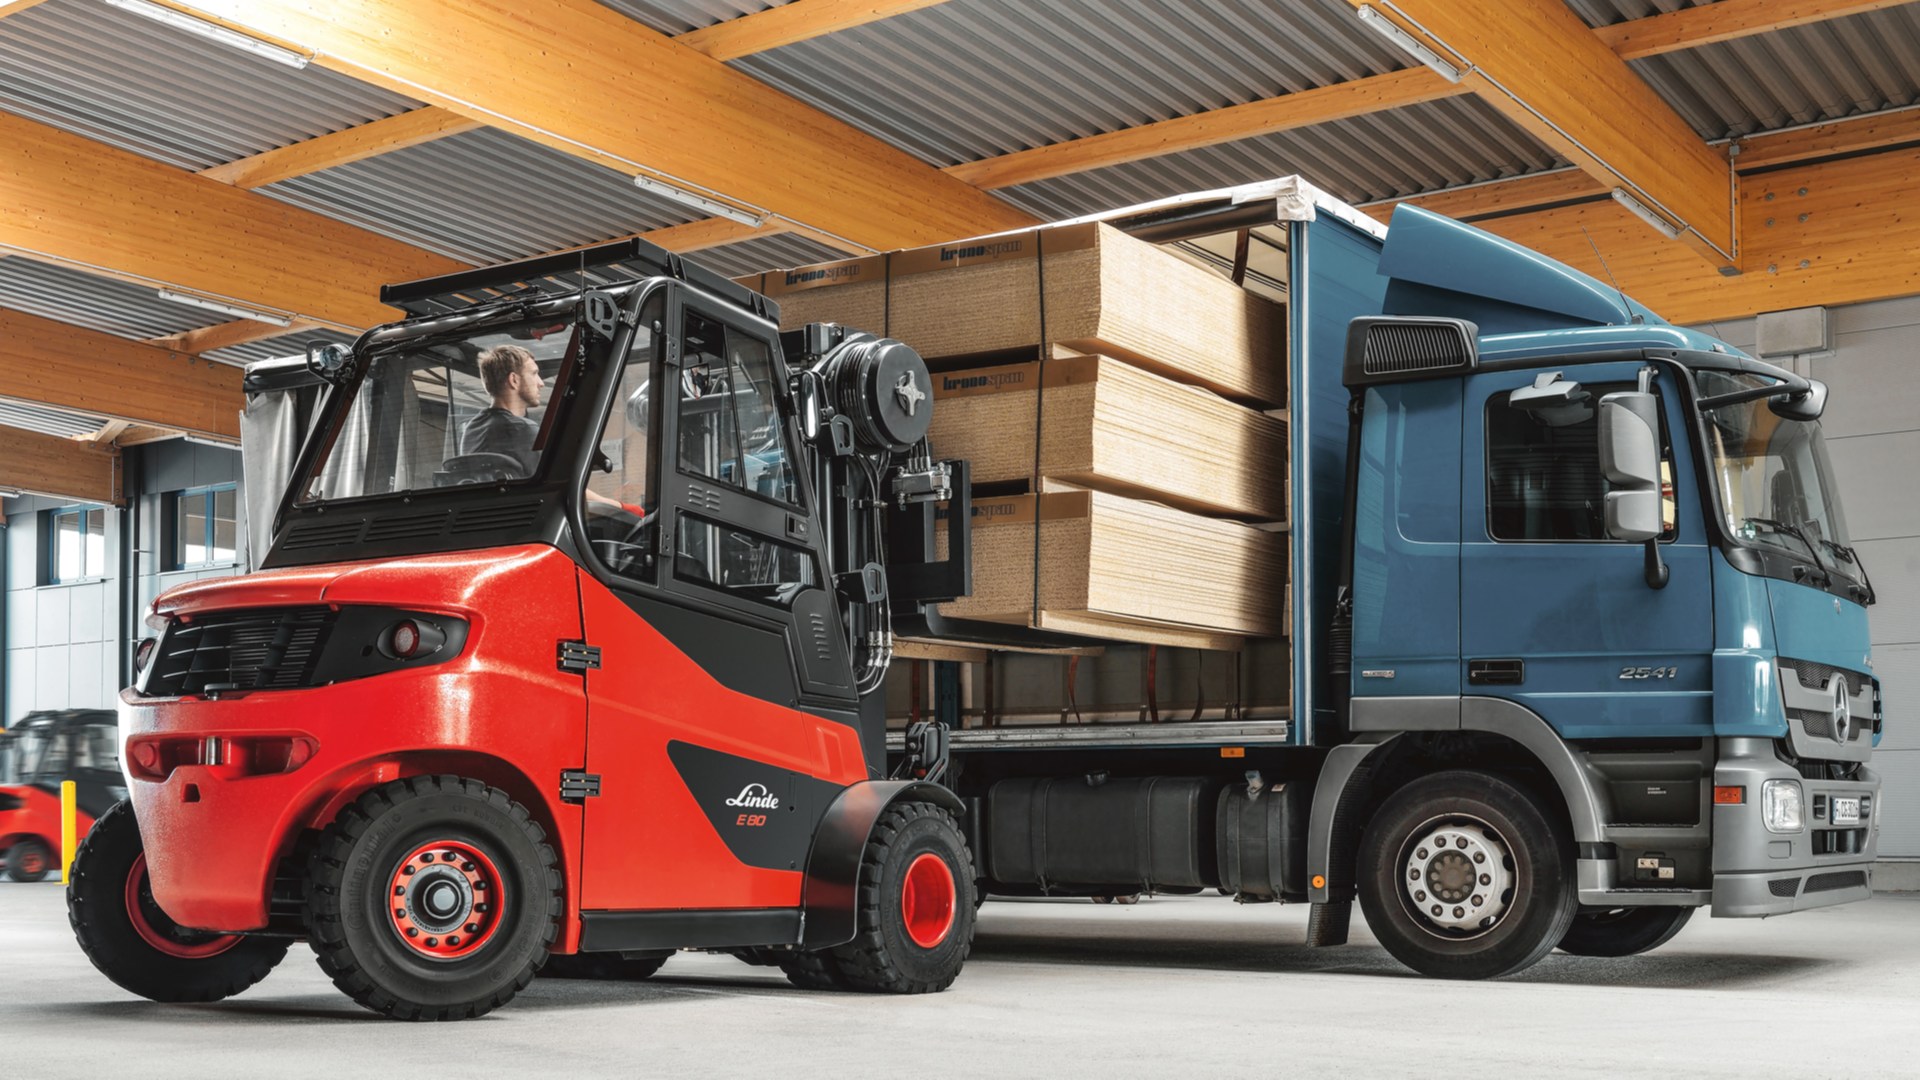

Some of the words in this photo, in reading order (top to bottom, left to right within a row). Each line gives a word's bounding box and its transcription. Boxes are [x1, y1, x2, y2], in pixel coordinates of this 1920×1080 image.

[940, 240, 1022, 262] kronospan
[785, 264, 860, 286] kronospan
[943, 371, 1025, 391] kronospan
[1619, 667, 1678, 679] 2541
[725, 783, 779, 809] Linde
[736, 814, 747, 826] E
[747, 814, 767, 827] 80
